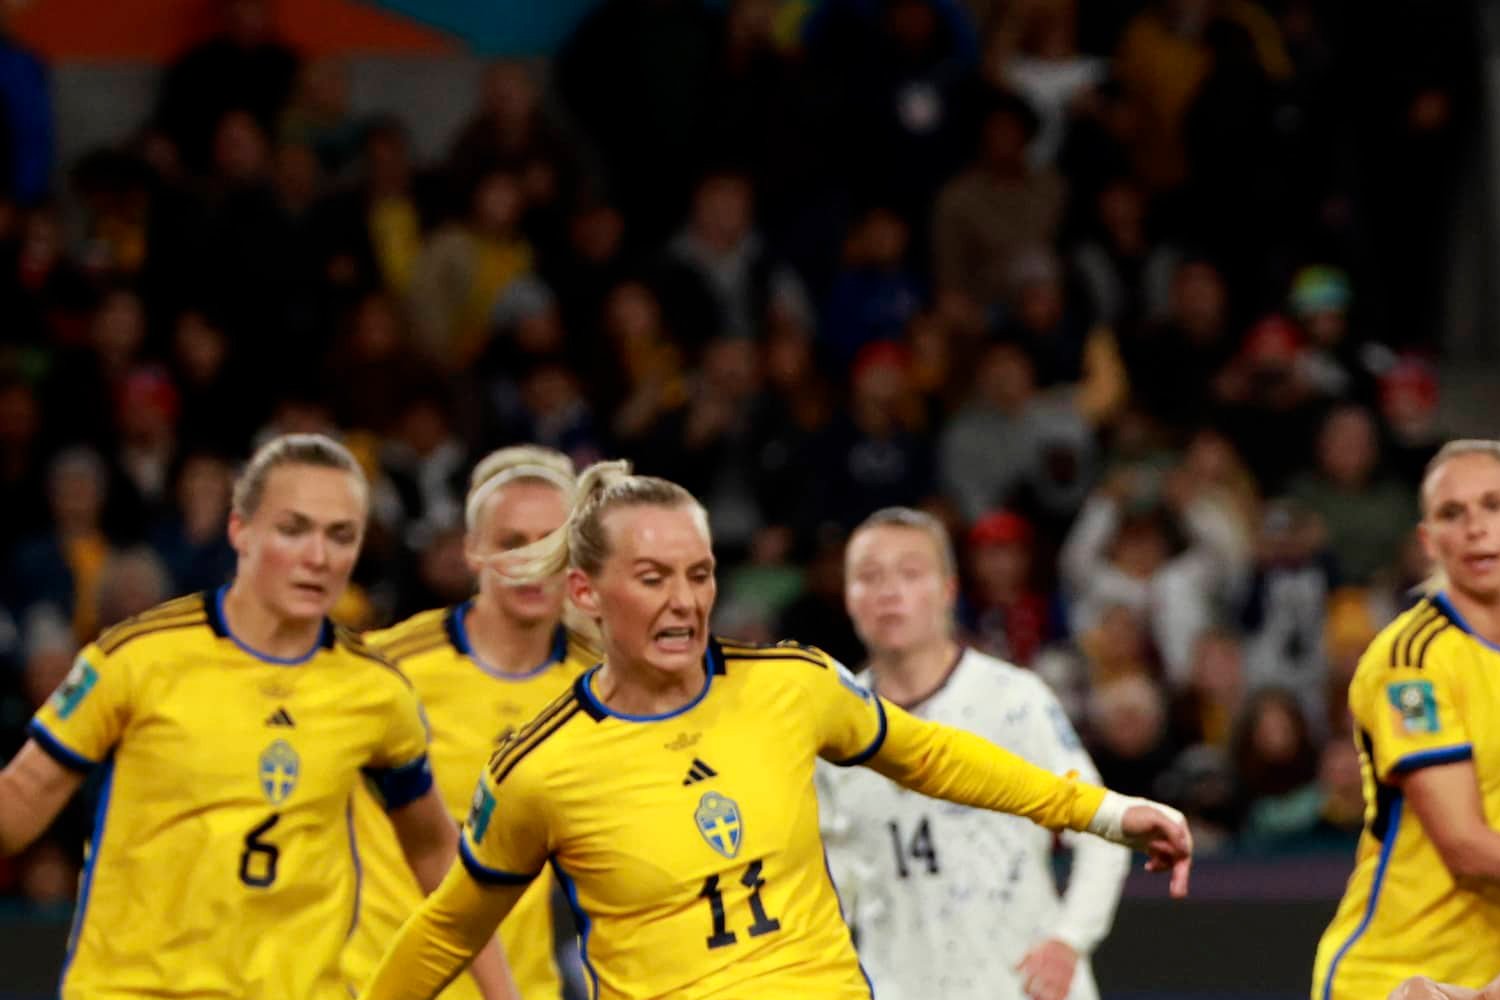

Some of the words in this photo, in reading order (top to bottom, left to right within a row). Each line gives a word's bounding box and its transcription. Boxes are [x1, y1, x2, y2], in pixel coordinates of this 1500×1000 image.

[240, 812, 280, 888] 6
[886, 816, 938, 878] 14
[697, 858, 781, 950] 11
